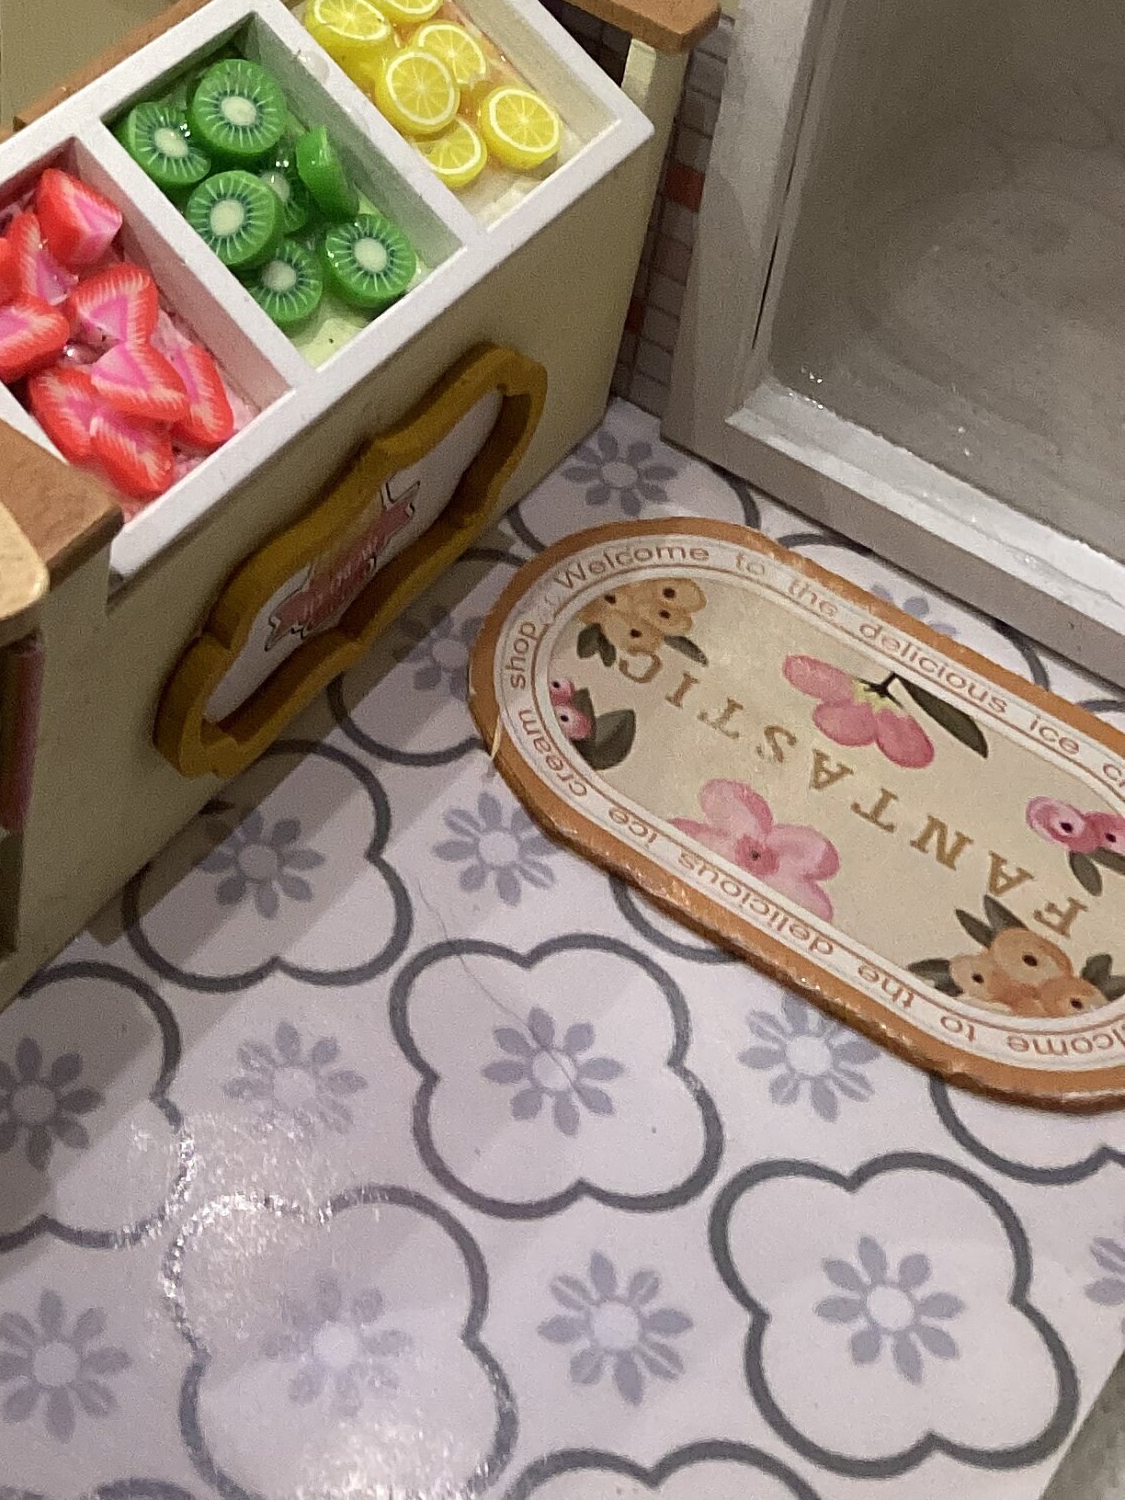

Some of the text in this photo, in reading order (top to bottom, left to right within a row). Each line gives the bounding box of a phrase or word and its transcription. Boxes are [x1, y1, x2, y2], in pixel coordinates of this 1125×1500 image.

[505, 620, 537, 690] shop
[554, 544, 1080, 755] Welcome to the delicious ice
[518, 708, 588, 798] cream
[608, 808, 658, 849] ice
[618, 650, 1088, 940] FANTASTIC
[677, 850, 835, 956] delicious
[857, 962, 918, 1011] the
[939, 1015, 976, 1043] to
